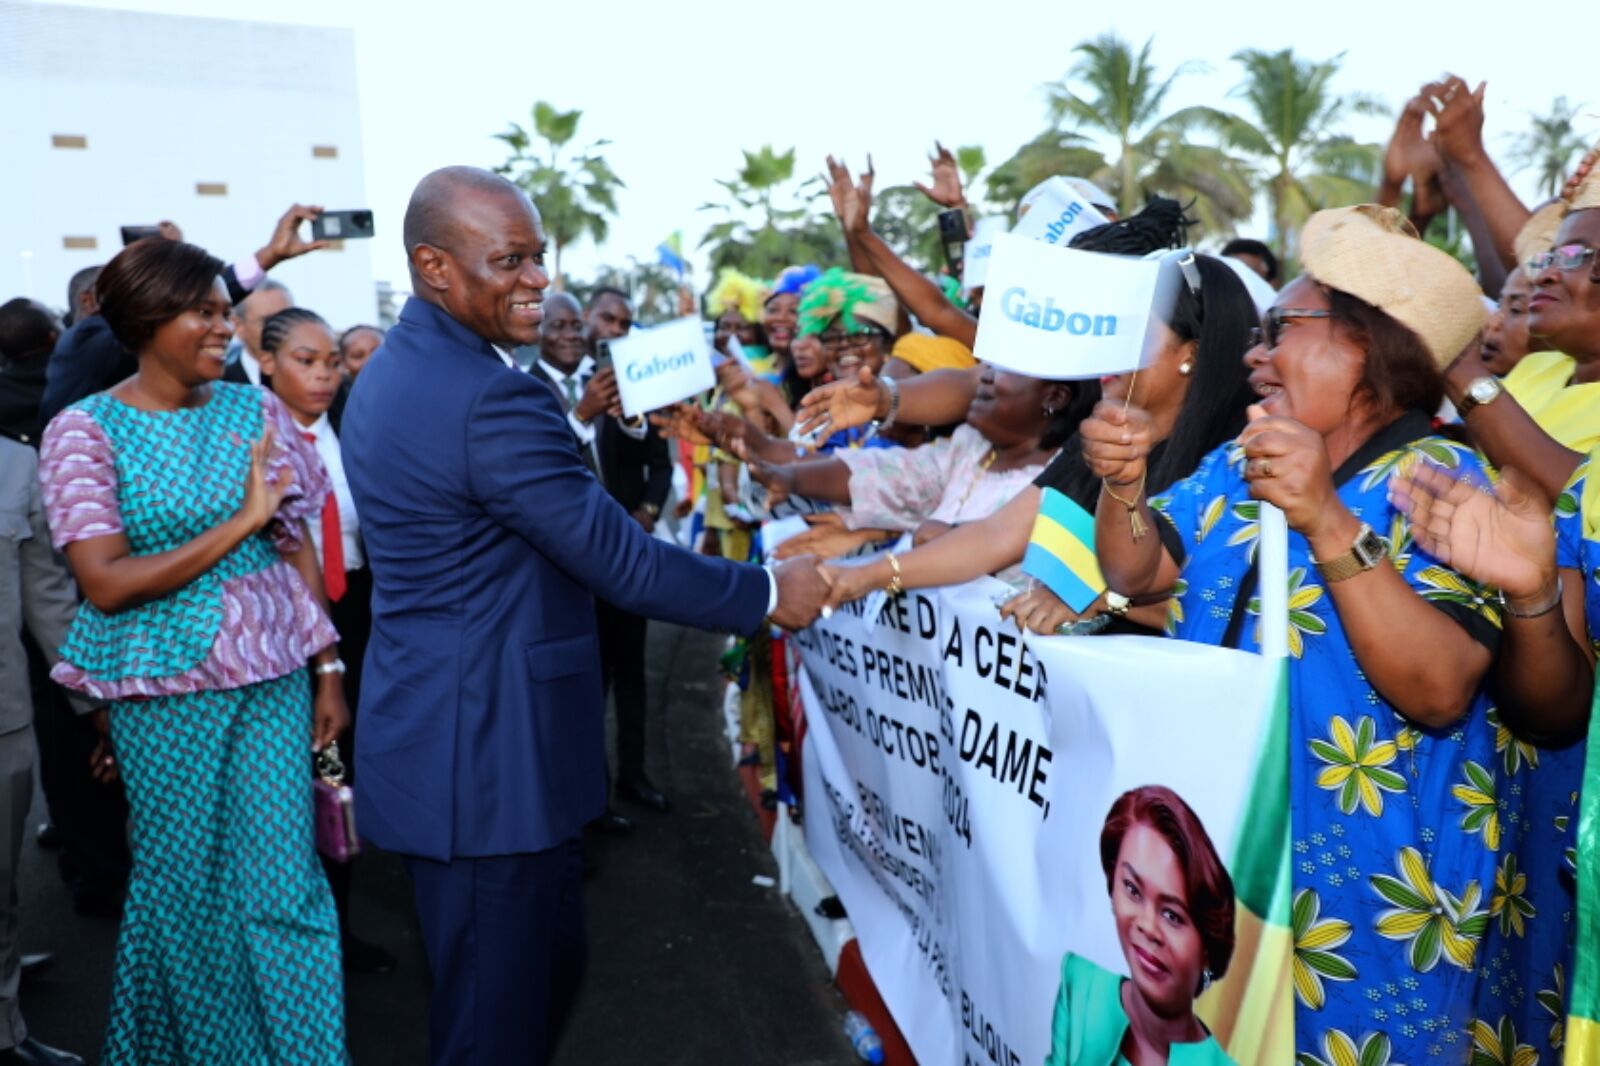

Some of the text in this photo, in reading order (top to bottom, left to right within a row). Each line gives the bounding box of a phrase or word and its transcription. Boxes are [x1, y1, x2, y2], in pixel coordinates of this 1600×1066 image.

[1043, 200, 1084, 245] abon
[1001, 286, 1118, 336] Gabon
[626, 351, 695, 383] Gabon
[916, 594, 937, 640] D
[941, 615, 963, 668] A
[974, 625, 1049, 703] CEEA
[866, 706, 941, 775] OCTOB
